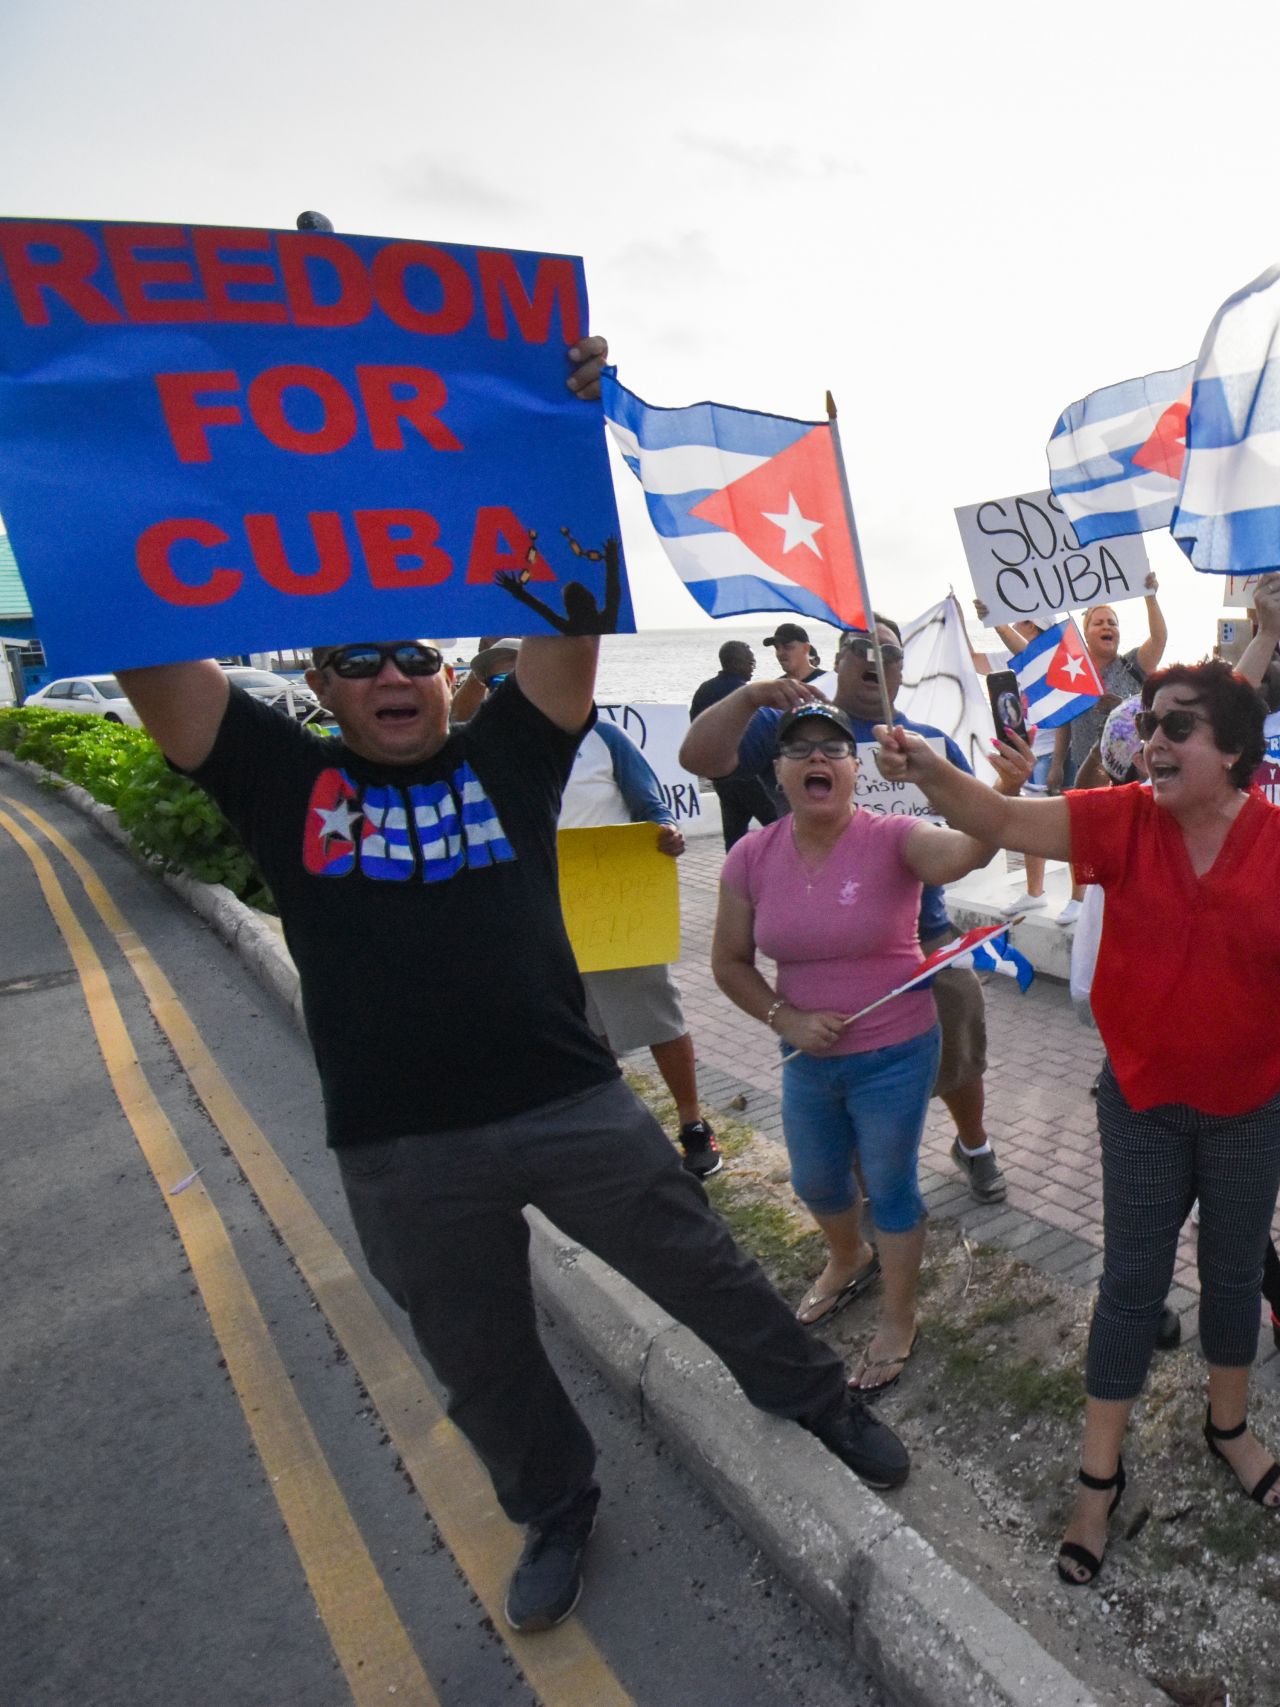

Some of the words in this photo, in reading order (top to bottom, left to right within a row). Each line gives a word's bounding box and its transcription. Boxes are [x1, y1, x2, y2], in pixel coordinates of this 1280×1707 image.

[0, 221, 583, 346] REEDOM
[154, 364, 464, 464] FOR
[134, 505, 557, 607] CUBA
[995, 545, 1130, 614] CUBA
[303, 758, 523, 885] CUBA
